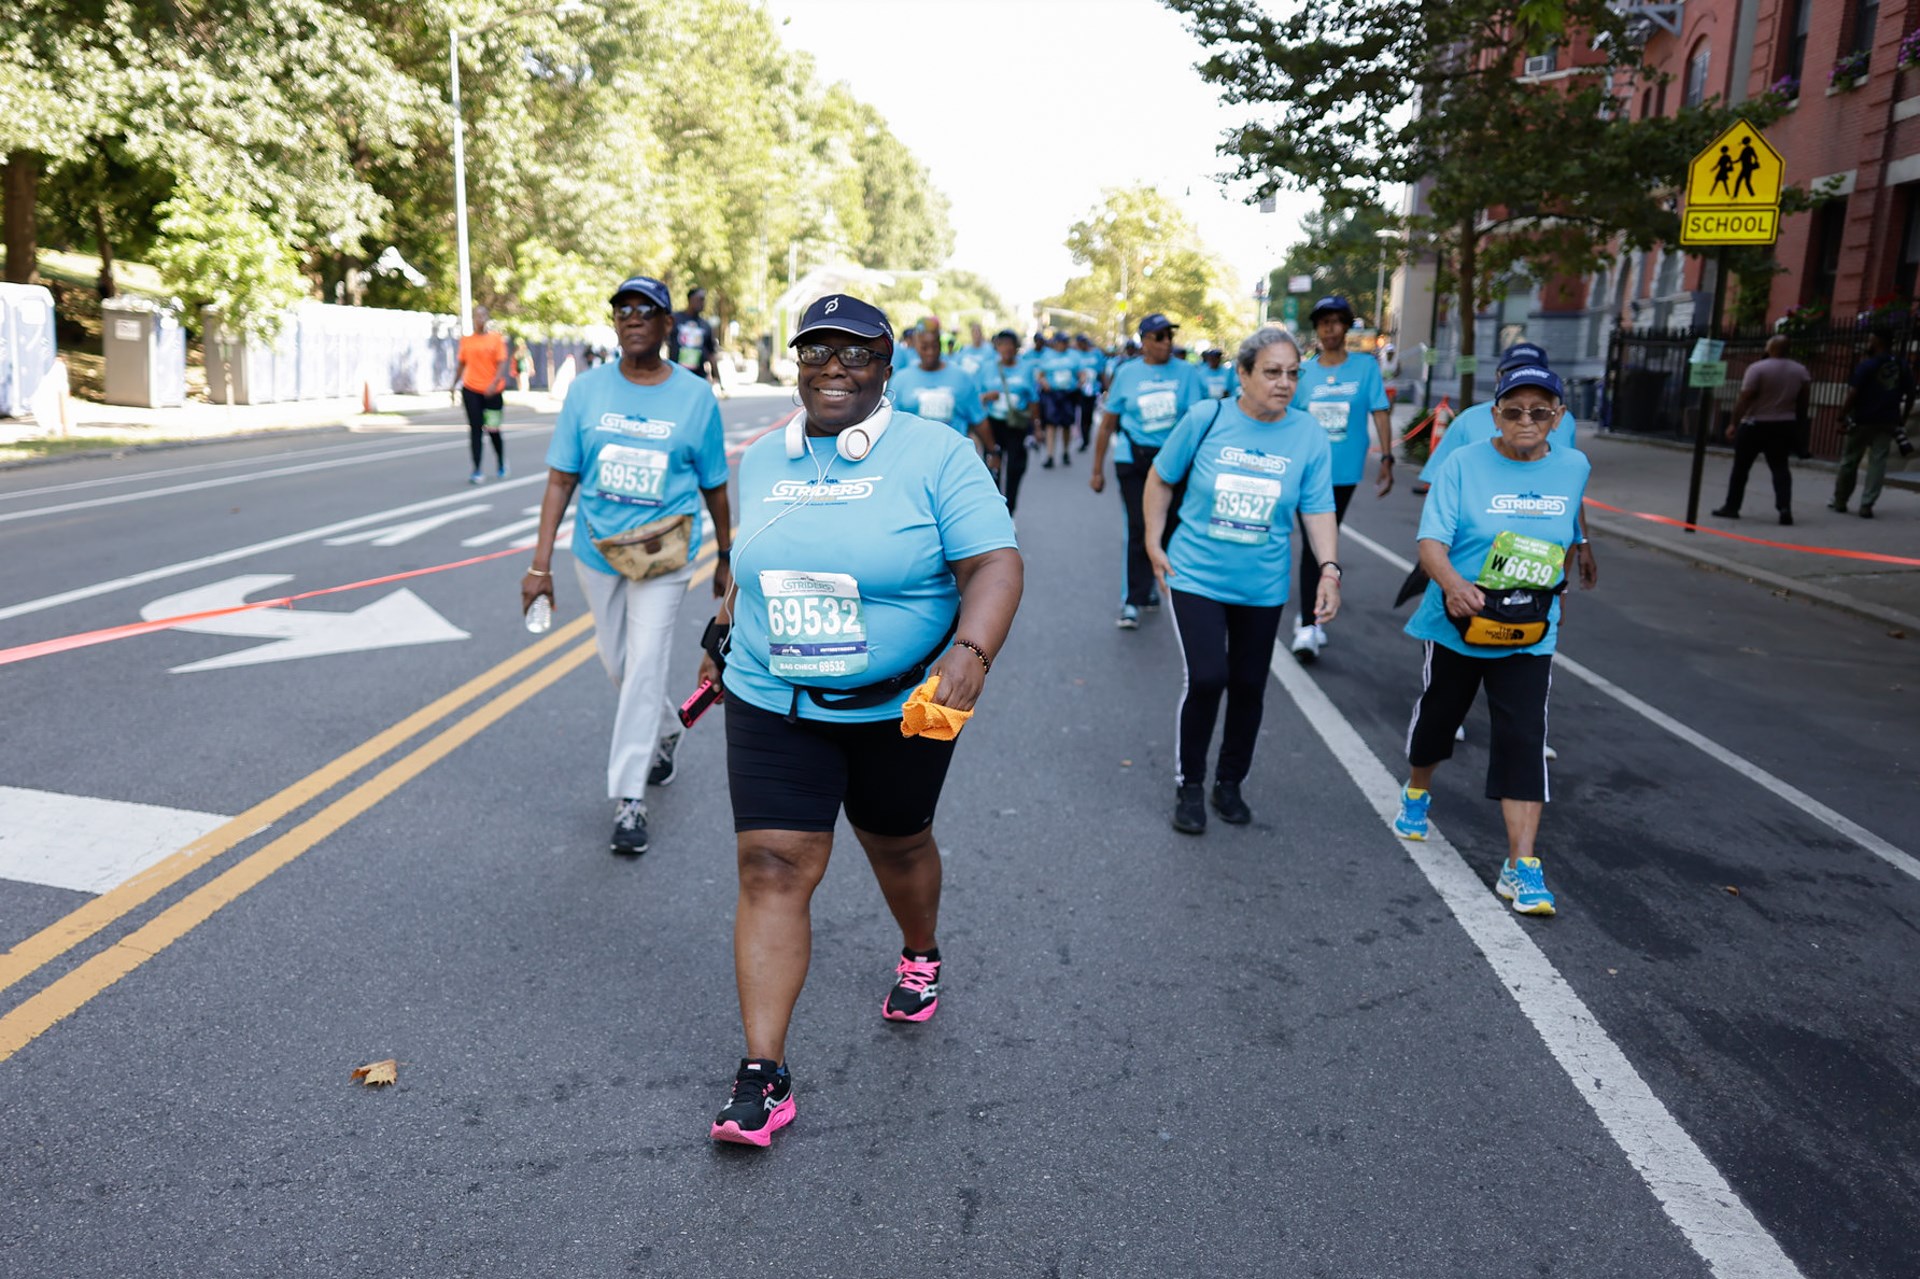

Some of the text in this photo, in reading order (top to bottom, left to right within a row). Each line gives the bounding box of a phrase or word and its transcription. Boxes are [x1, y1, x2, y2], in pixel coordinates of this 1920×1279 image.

[1690, 216, 1768, 233] SCHOOL
[601, 461, 663, 495] 69537
[772, 481, 873, 499] STRIDERS
[1216, 490, 1277, 520] 69527
[1493, 497, 1564, 512] STRIDERS
[1491, 554, 1552, 586] W6639
[768, 597, 861, 636] 69532
[780, 660, 847, 673] BAG CHECK 69532
